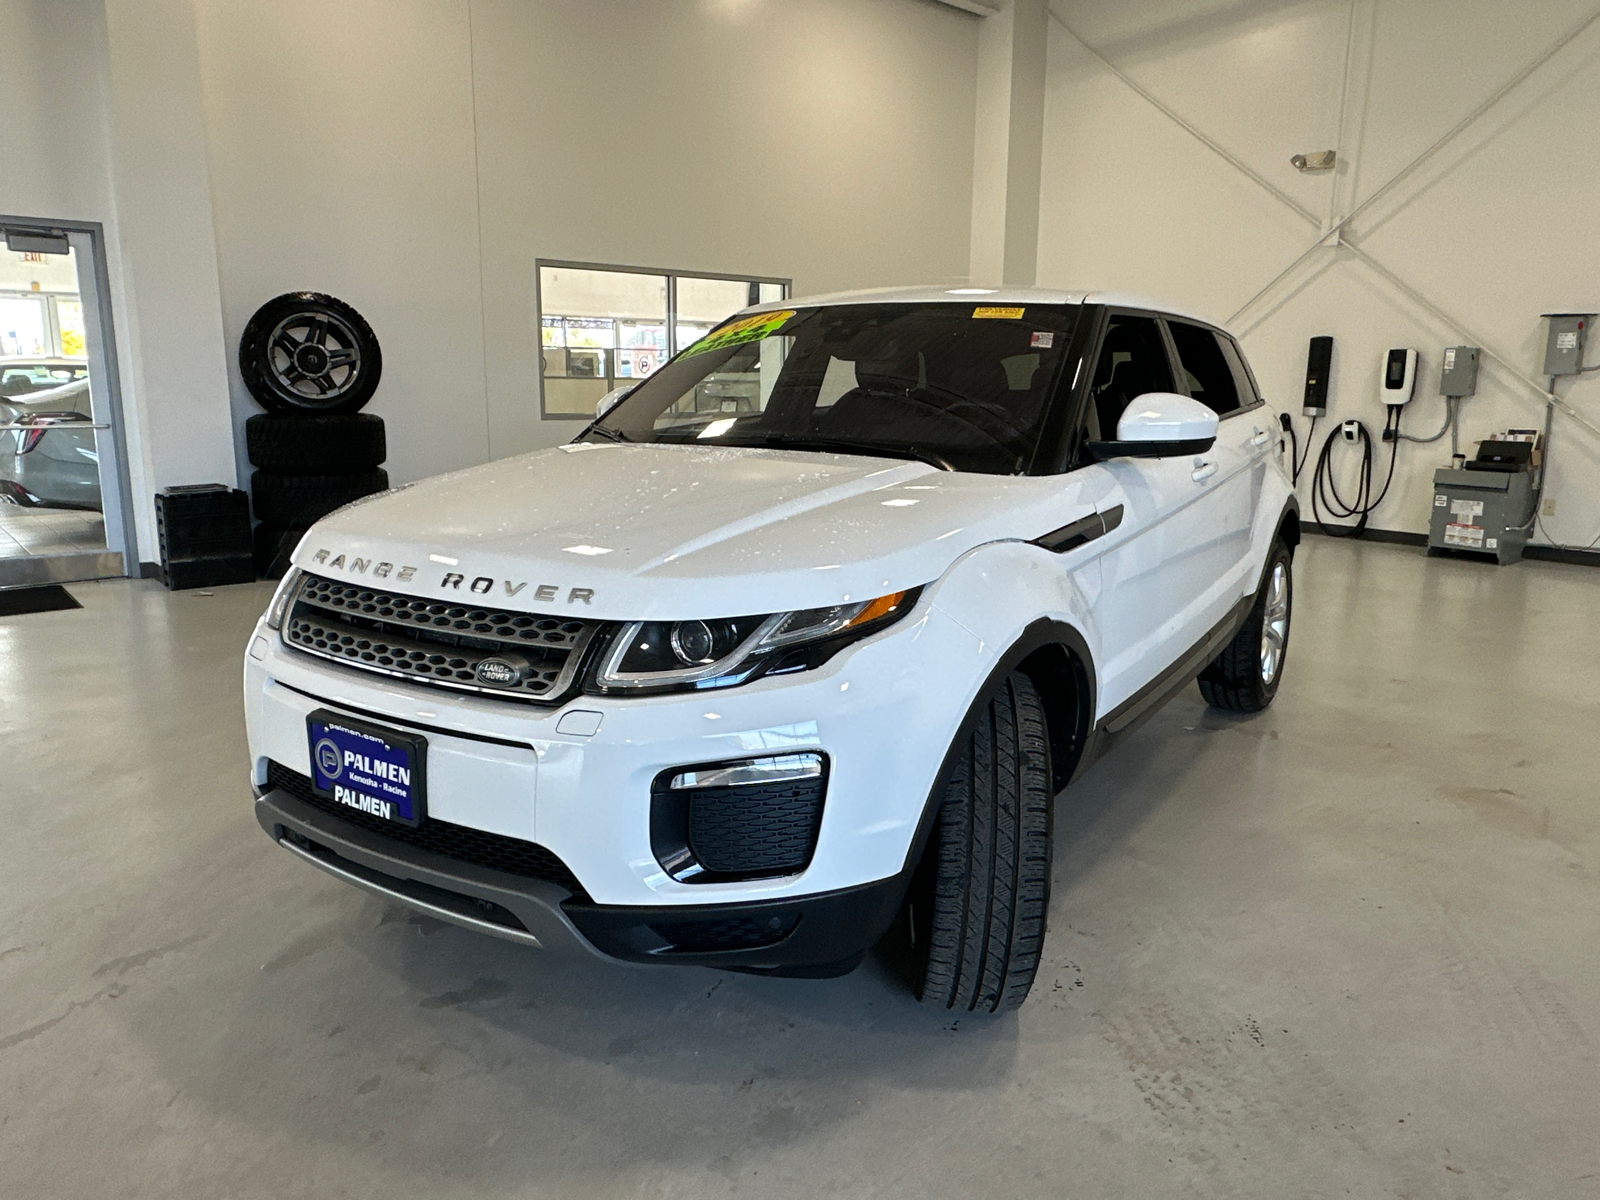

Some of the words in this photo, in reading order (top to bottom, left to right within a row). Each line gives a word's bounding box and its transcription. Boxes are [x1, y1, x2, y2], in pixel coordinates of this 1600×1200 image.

[312, 548, 418, 582] RANGE
[440, 572, 596, 605] ROVER
[484, 663, 505, 673] LAND
[485, 671, 510, 681] ROVER
[328, 723, 385, 744] palmen.com
[344, 750, 411, 786] PALMEN
[349, 772, 378, 788] Kenosha
[383, 783, 407, 798] Racine
[334, 785, 391, 820] PALMEN
